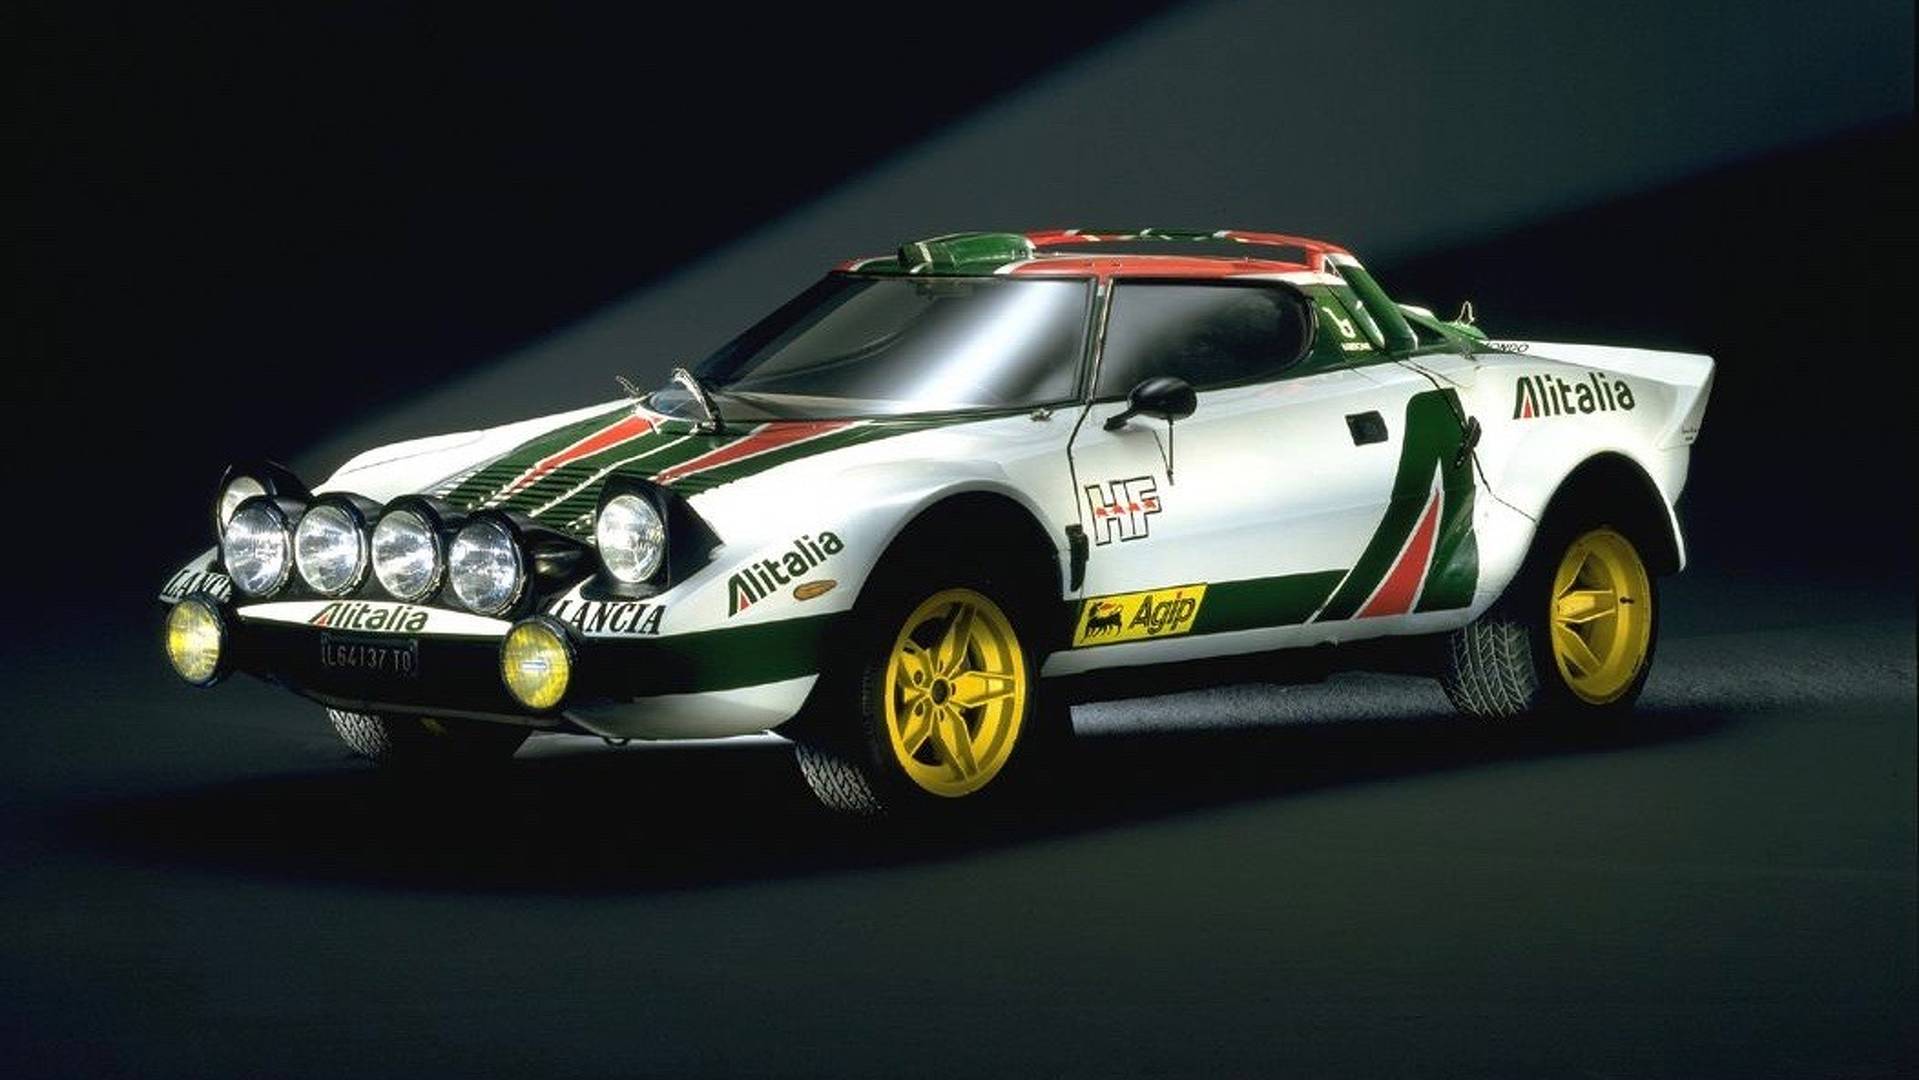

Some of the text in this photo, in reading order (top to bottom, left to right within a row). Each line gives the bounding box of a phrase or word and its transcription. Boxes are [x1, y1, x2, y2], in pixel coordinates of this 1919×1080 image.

[1513, 372, 1636, 421] Alitalia
[1084, 475, 1162, 546] HF
[728, 530, 845, 618] Alitalia
[308, 602, 429, 632] Alitalia
[1128, 590, 1196, 634] Agip
